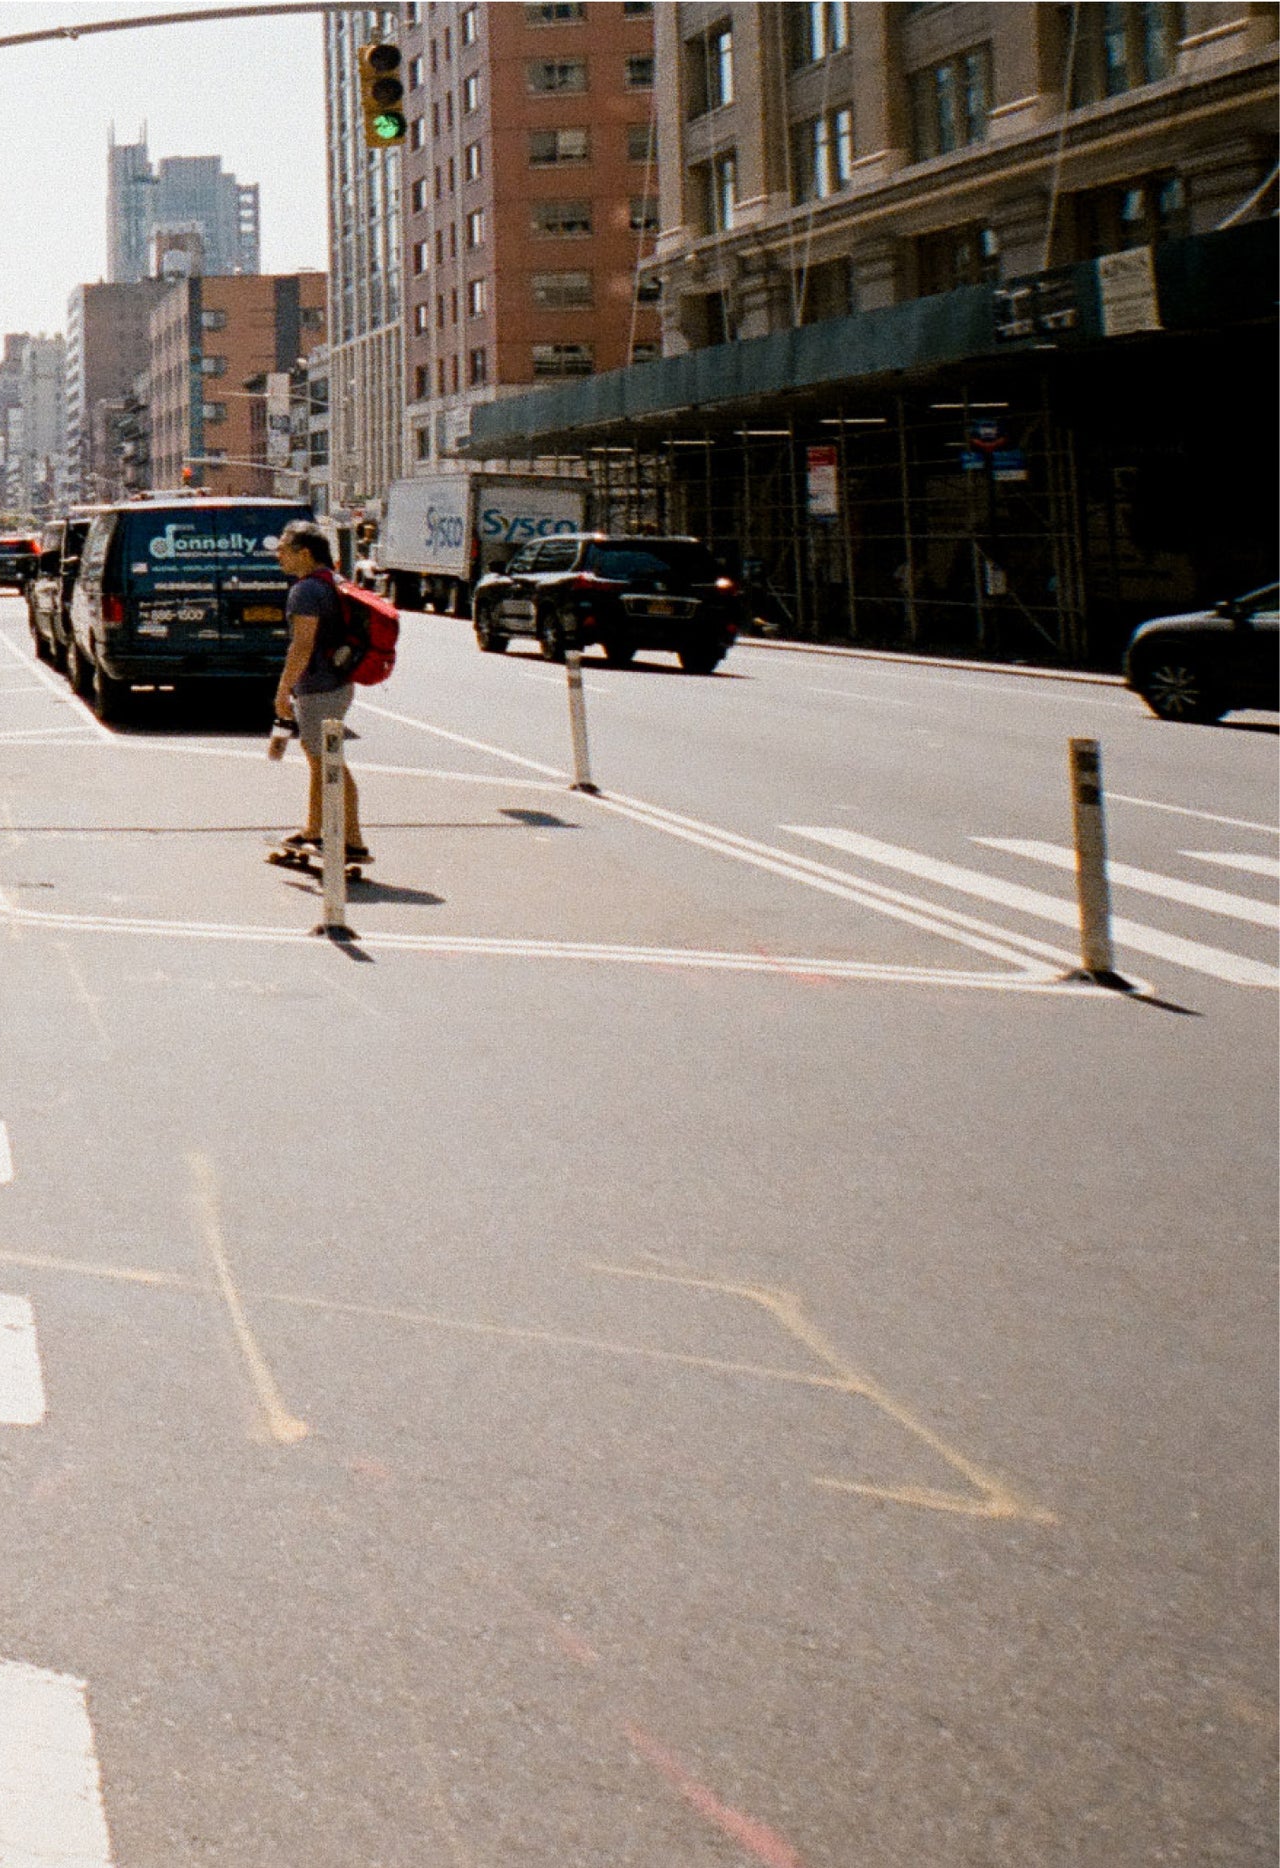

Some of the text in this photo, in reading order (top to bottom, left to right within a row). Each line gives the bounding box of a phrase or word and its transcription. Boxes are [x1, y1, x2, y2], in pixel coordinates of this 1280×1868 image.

[149, 523, 258, 559] donnelly
[426, 506, 463, 554] Sysco
[482, 508, 578, 541] Sysco
